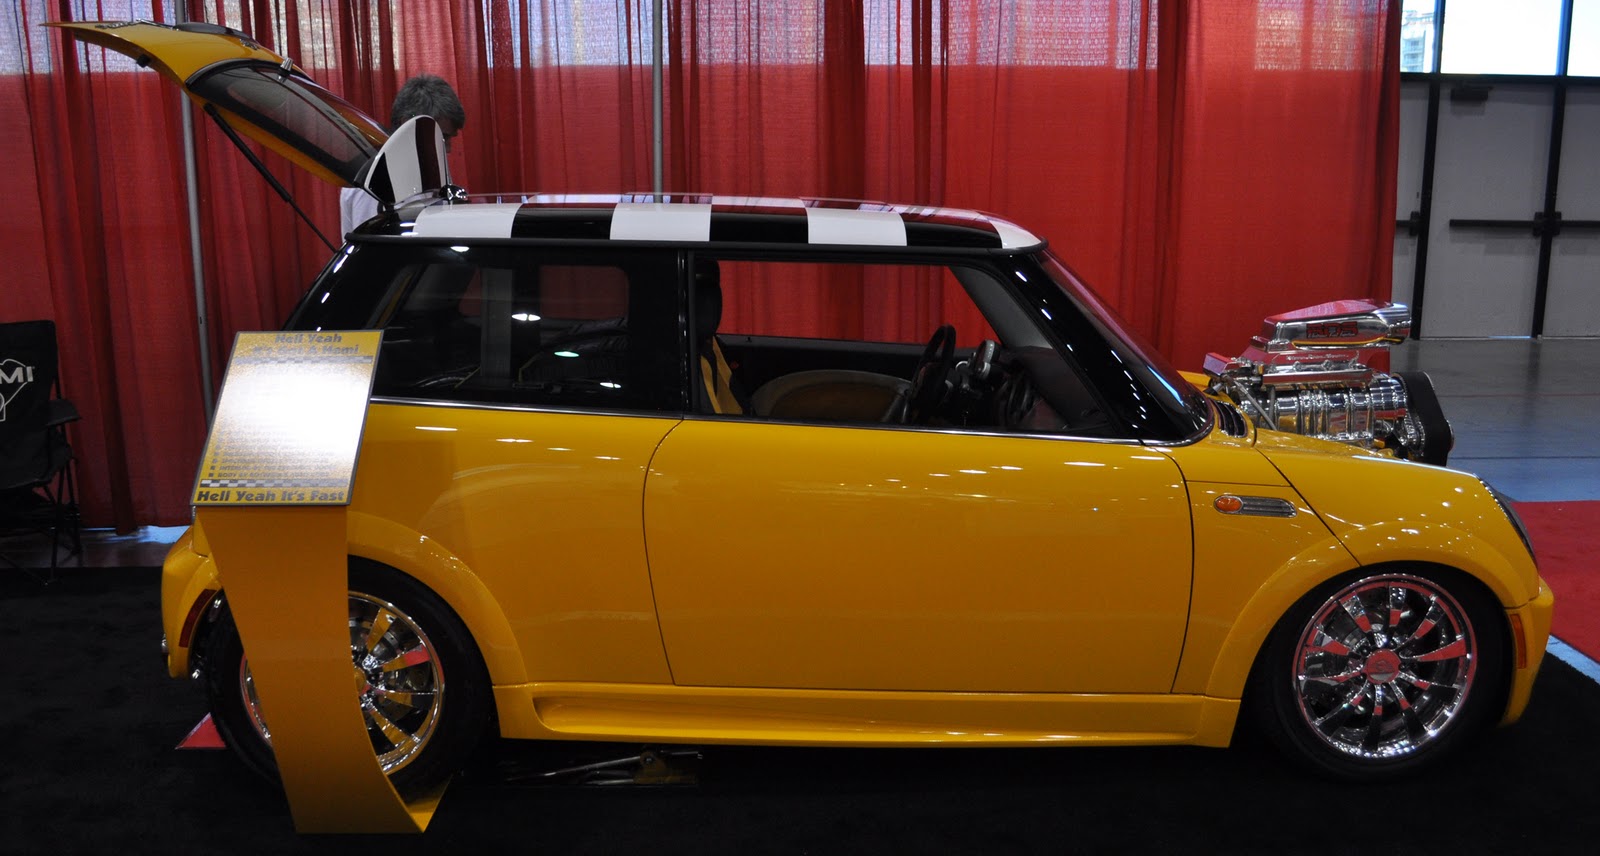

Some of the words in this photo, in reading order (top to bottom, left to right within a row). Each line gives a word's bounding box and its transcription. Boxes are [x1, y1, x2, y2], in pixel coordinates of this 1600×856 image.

[275, 333, 303, 344] Hell
[308, 333, 342, 343] Yeah
[197, 490, 230, 502] Hell
[236, 490, 276, 502] Yeah
[281, 490, 304, 502] It's
[310, 490, 345, 502] Fast
